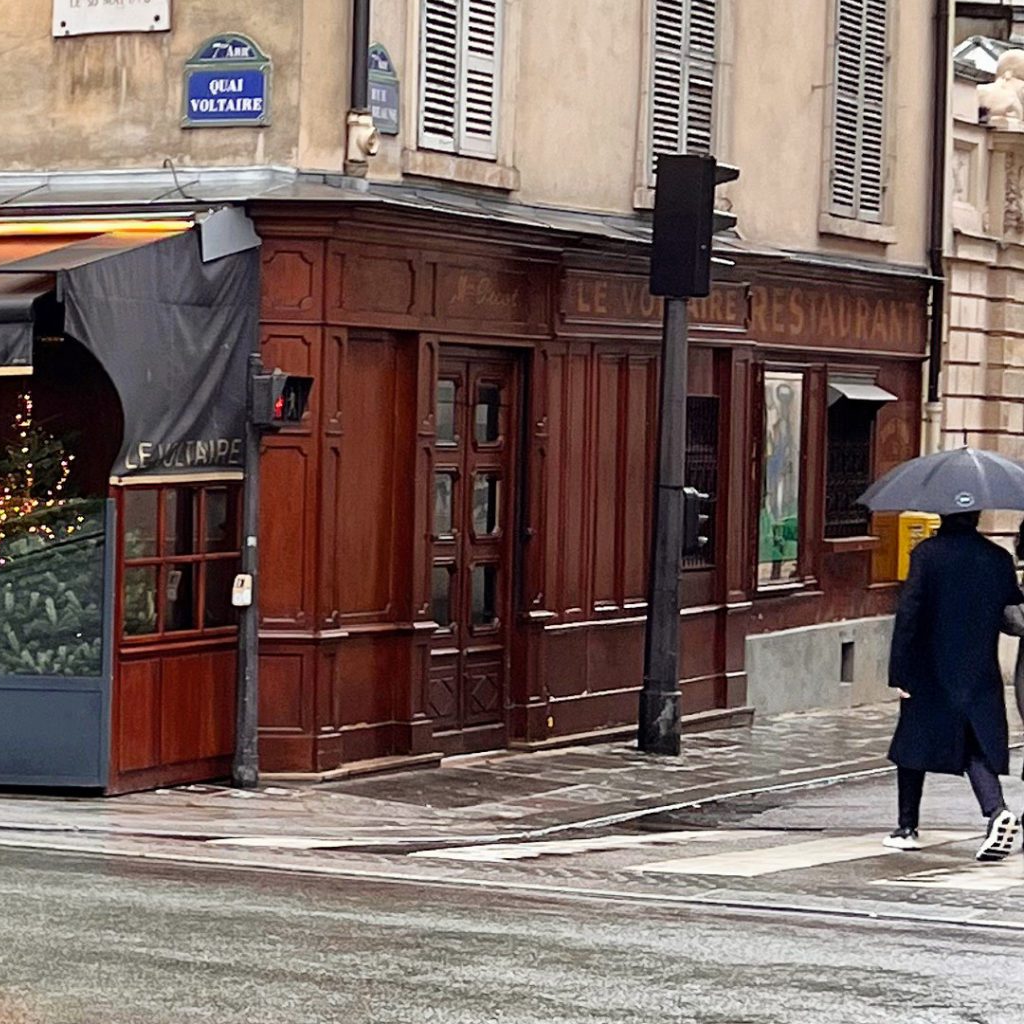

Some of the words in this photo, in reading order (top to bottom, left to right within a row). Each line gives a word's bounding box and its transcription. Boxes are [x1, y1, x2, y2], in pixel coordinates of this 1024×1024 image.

[209, 78, 244, 96] QUAI
[190, 97, 263, 112] VOLTAIRE
[577, 279, 608, 314] LE
[751, 285, 919, 345] RESTAURANT
